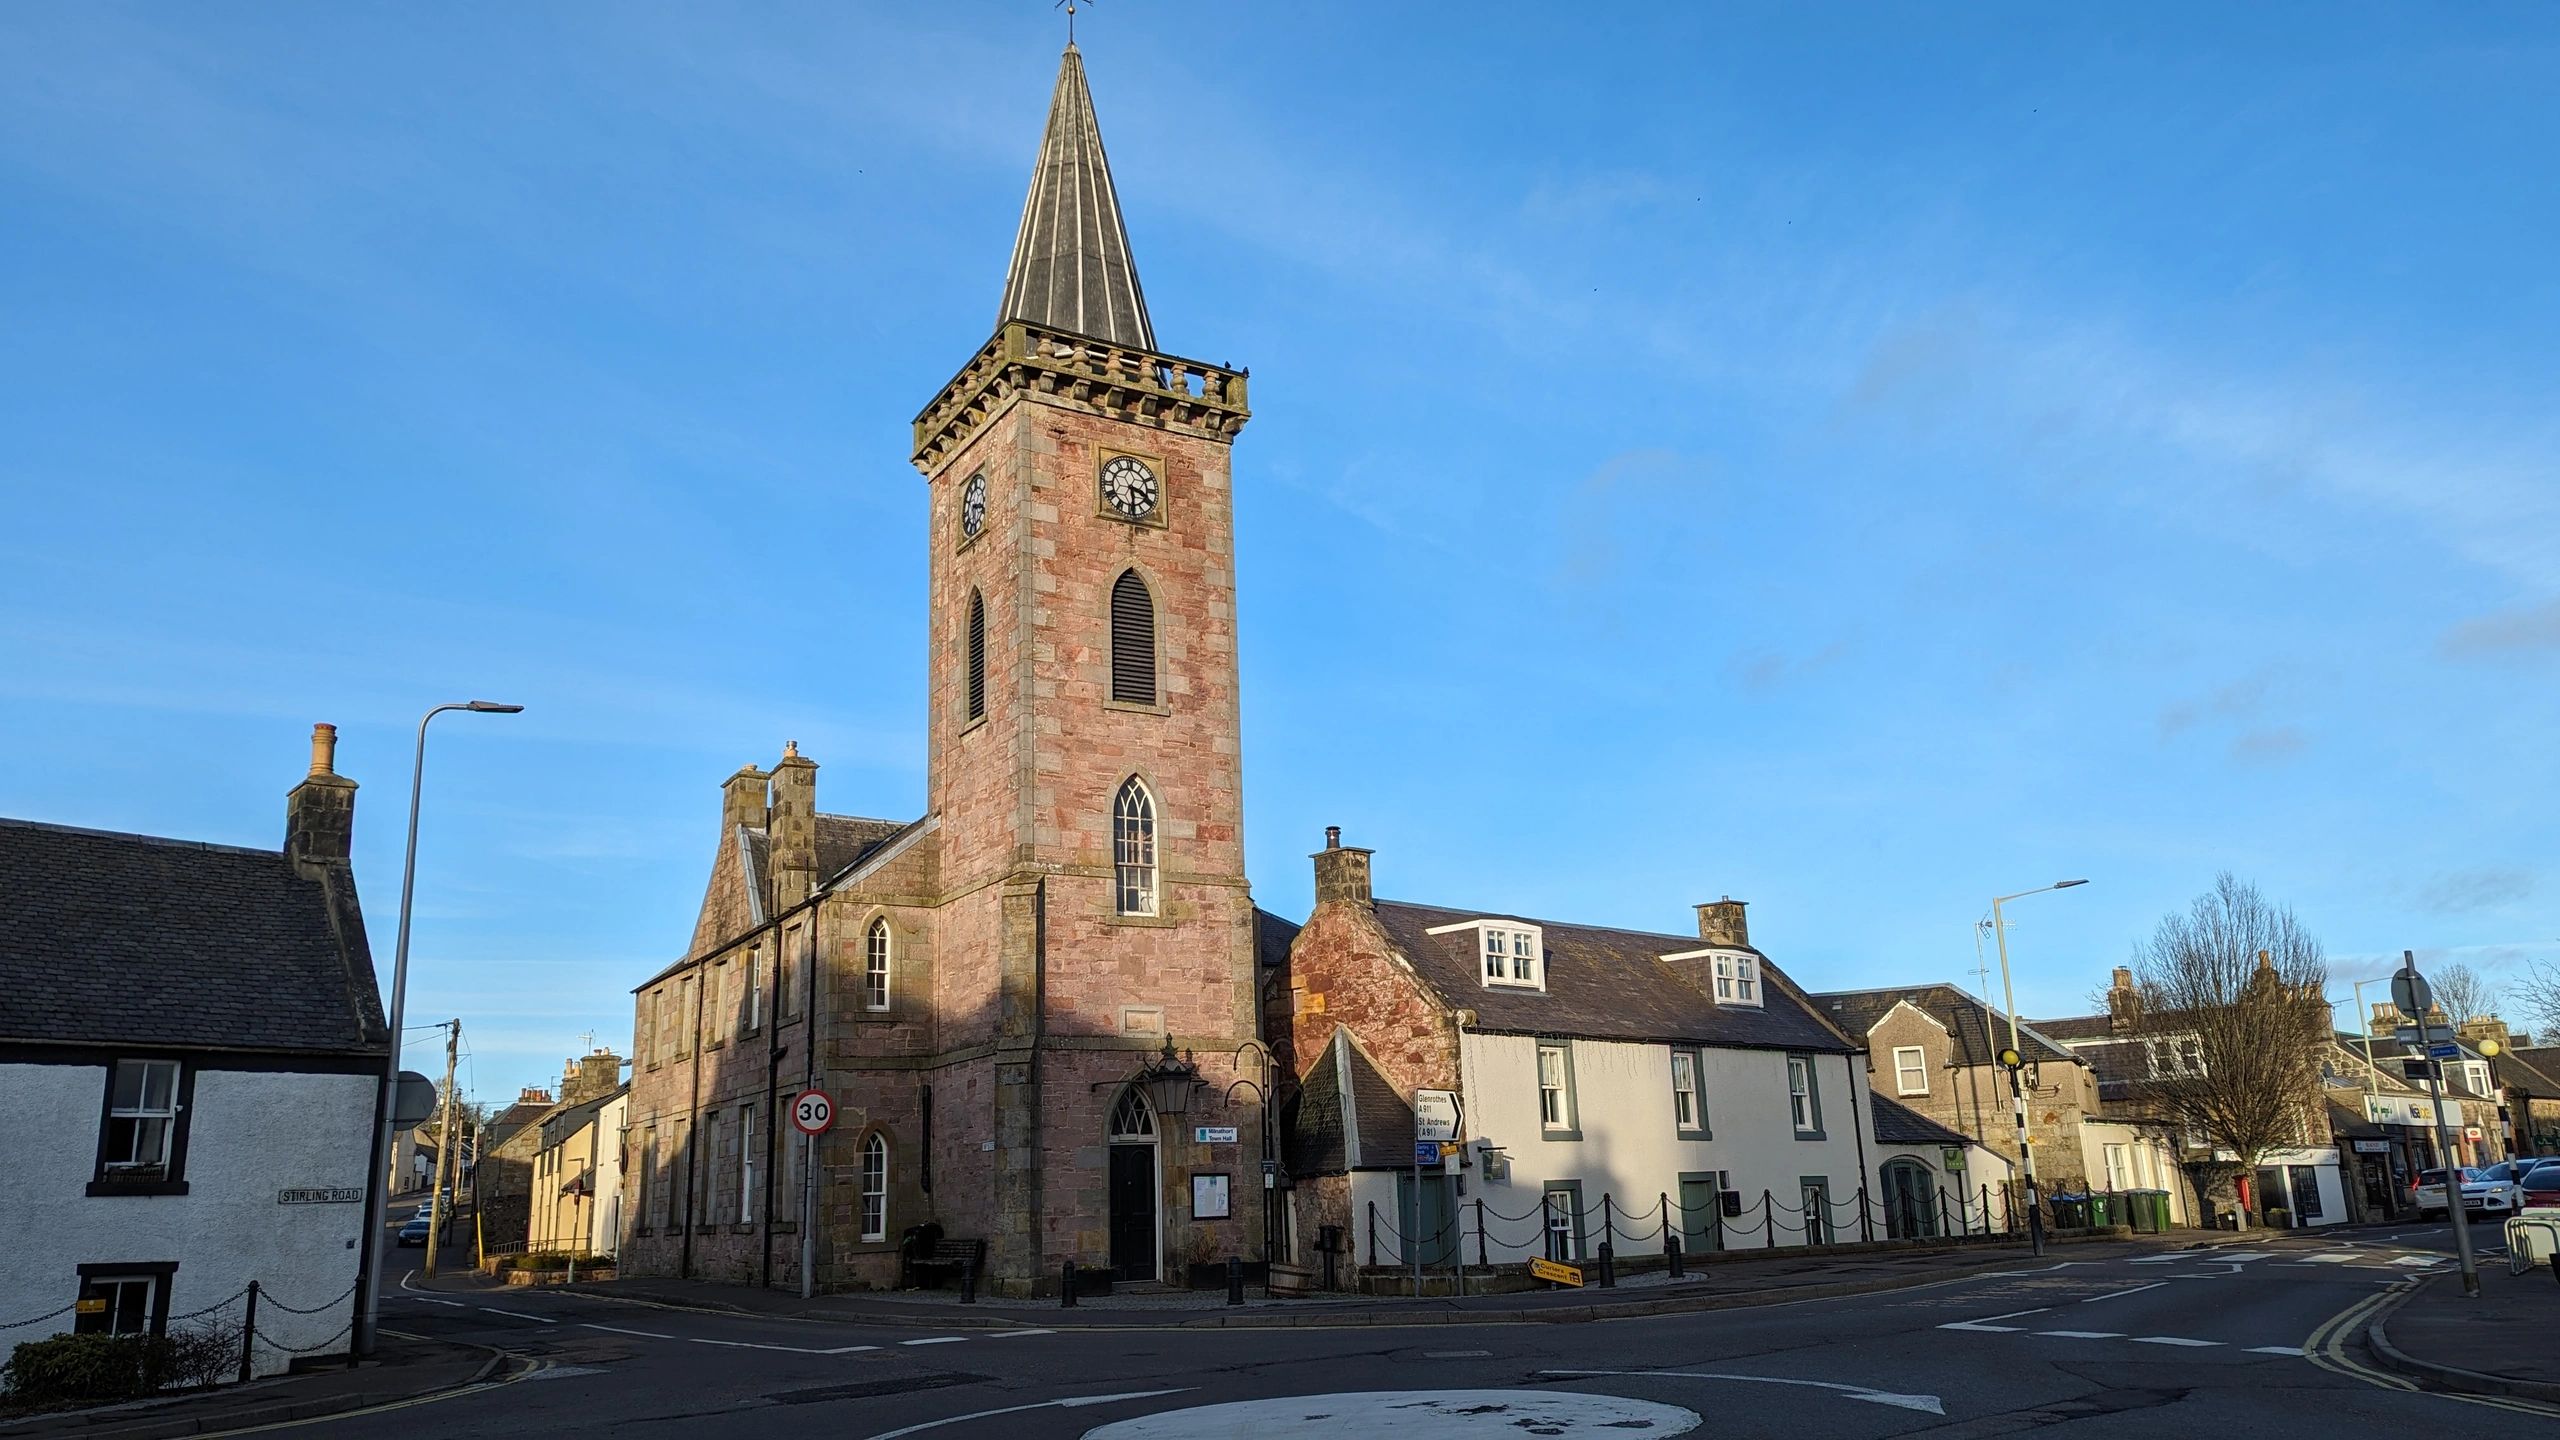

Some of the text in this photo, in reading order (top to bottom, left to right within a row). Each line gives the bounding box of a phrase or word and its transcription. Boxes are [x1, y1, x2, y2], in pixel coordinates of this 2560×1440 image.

[1418, 1094, 1447, 1103] Glenrothes
[799, 1103, 828, 1121] 30
[1418, 1117, 1450, 1126] St Andrews
[283, 1190, 359, 1202] STIRLING ROAD
[1538, 1268, 1568, 1280] Crescent
